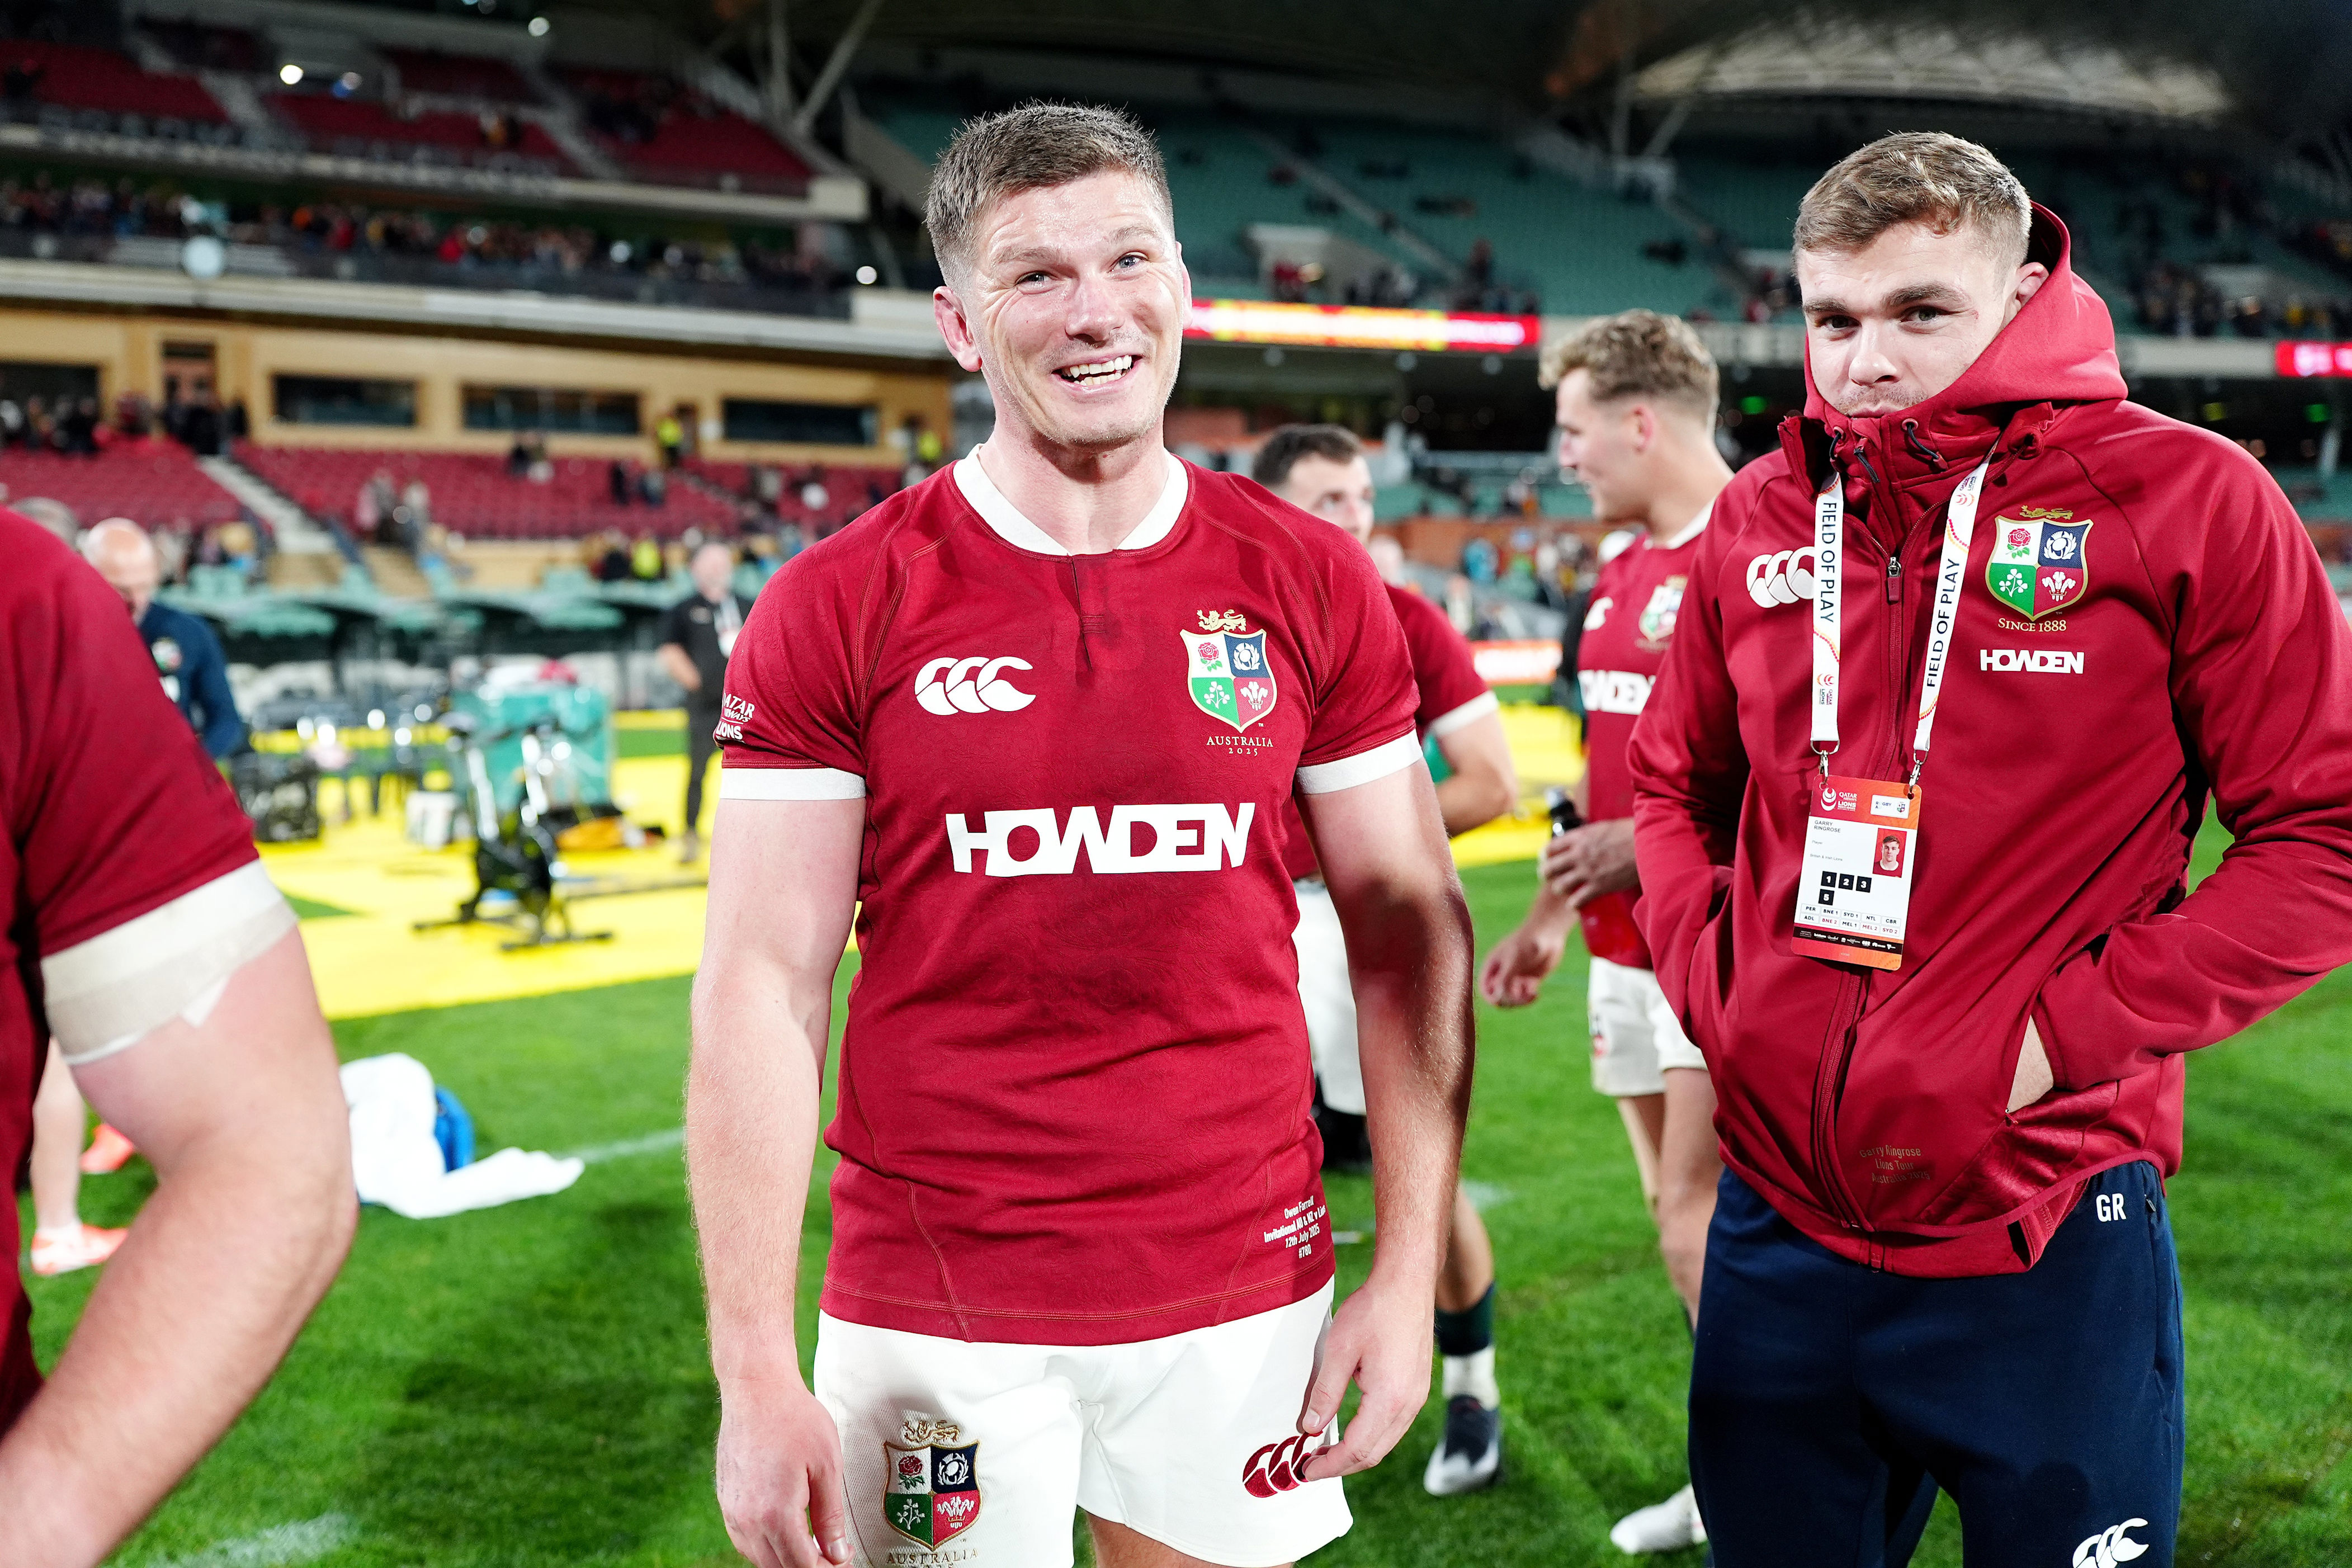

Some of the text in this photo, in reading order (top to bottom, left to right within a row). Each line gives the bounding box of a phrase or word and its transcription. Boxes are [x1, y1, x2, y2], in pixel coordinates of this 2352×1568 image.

[1820, 503, 1837, 622] FIELD OF PLAY
[1926, 558, 1960, 687] FIELD OF PLAY
[1997, 617, 2067, 632] SINCE 1888
[1980, 649, 2085, 674] HOWDEN
[715, 721, 743, 740] LIONS
[1206, 736, 1273, 748] AUSTRALIA
[1229, 748, 1258, 757] 2025
[945, 802, 1256, 877] HOWDEN
[1823, 893, 1830, 901] 5
[1859, 1145, 1921, 1159] Garry Ringrose
[1875, 1158, 1915, 1170] Lions Tour
[1871, 1172, 1907, 1184] Australia
[1284, 1195, 1314, 1219] Owen Farrell
[2096, 1193, 2127, 1222] GR
[1264, 1220, 1297, 1243] Invitational
[1296, 1217, 1304, 1230] AU
[1302, 1216, 1308, 1226] &
[1306, 1211, 1315, 1224] NZ
[1314, 1211, 1318, 1220] v
[1285, 1222, 1320, 1248] 12th July 2025
[1298, 1244, 1312, 1259] #780
[886, 1547, 979, 1565] AUSTRALIA
